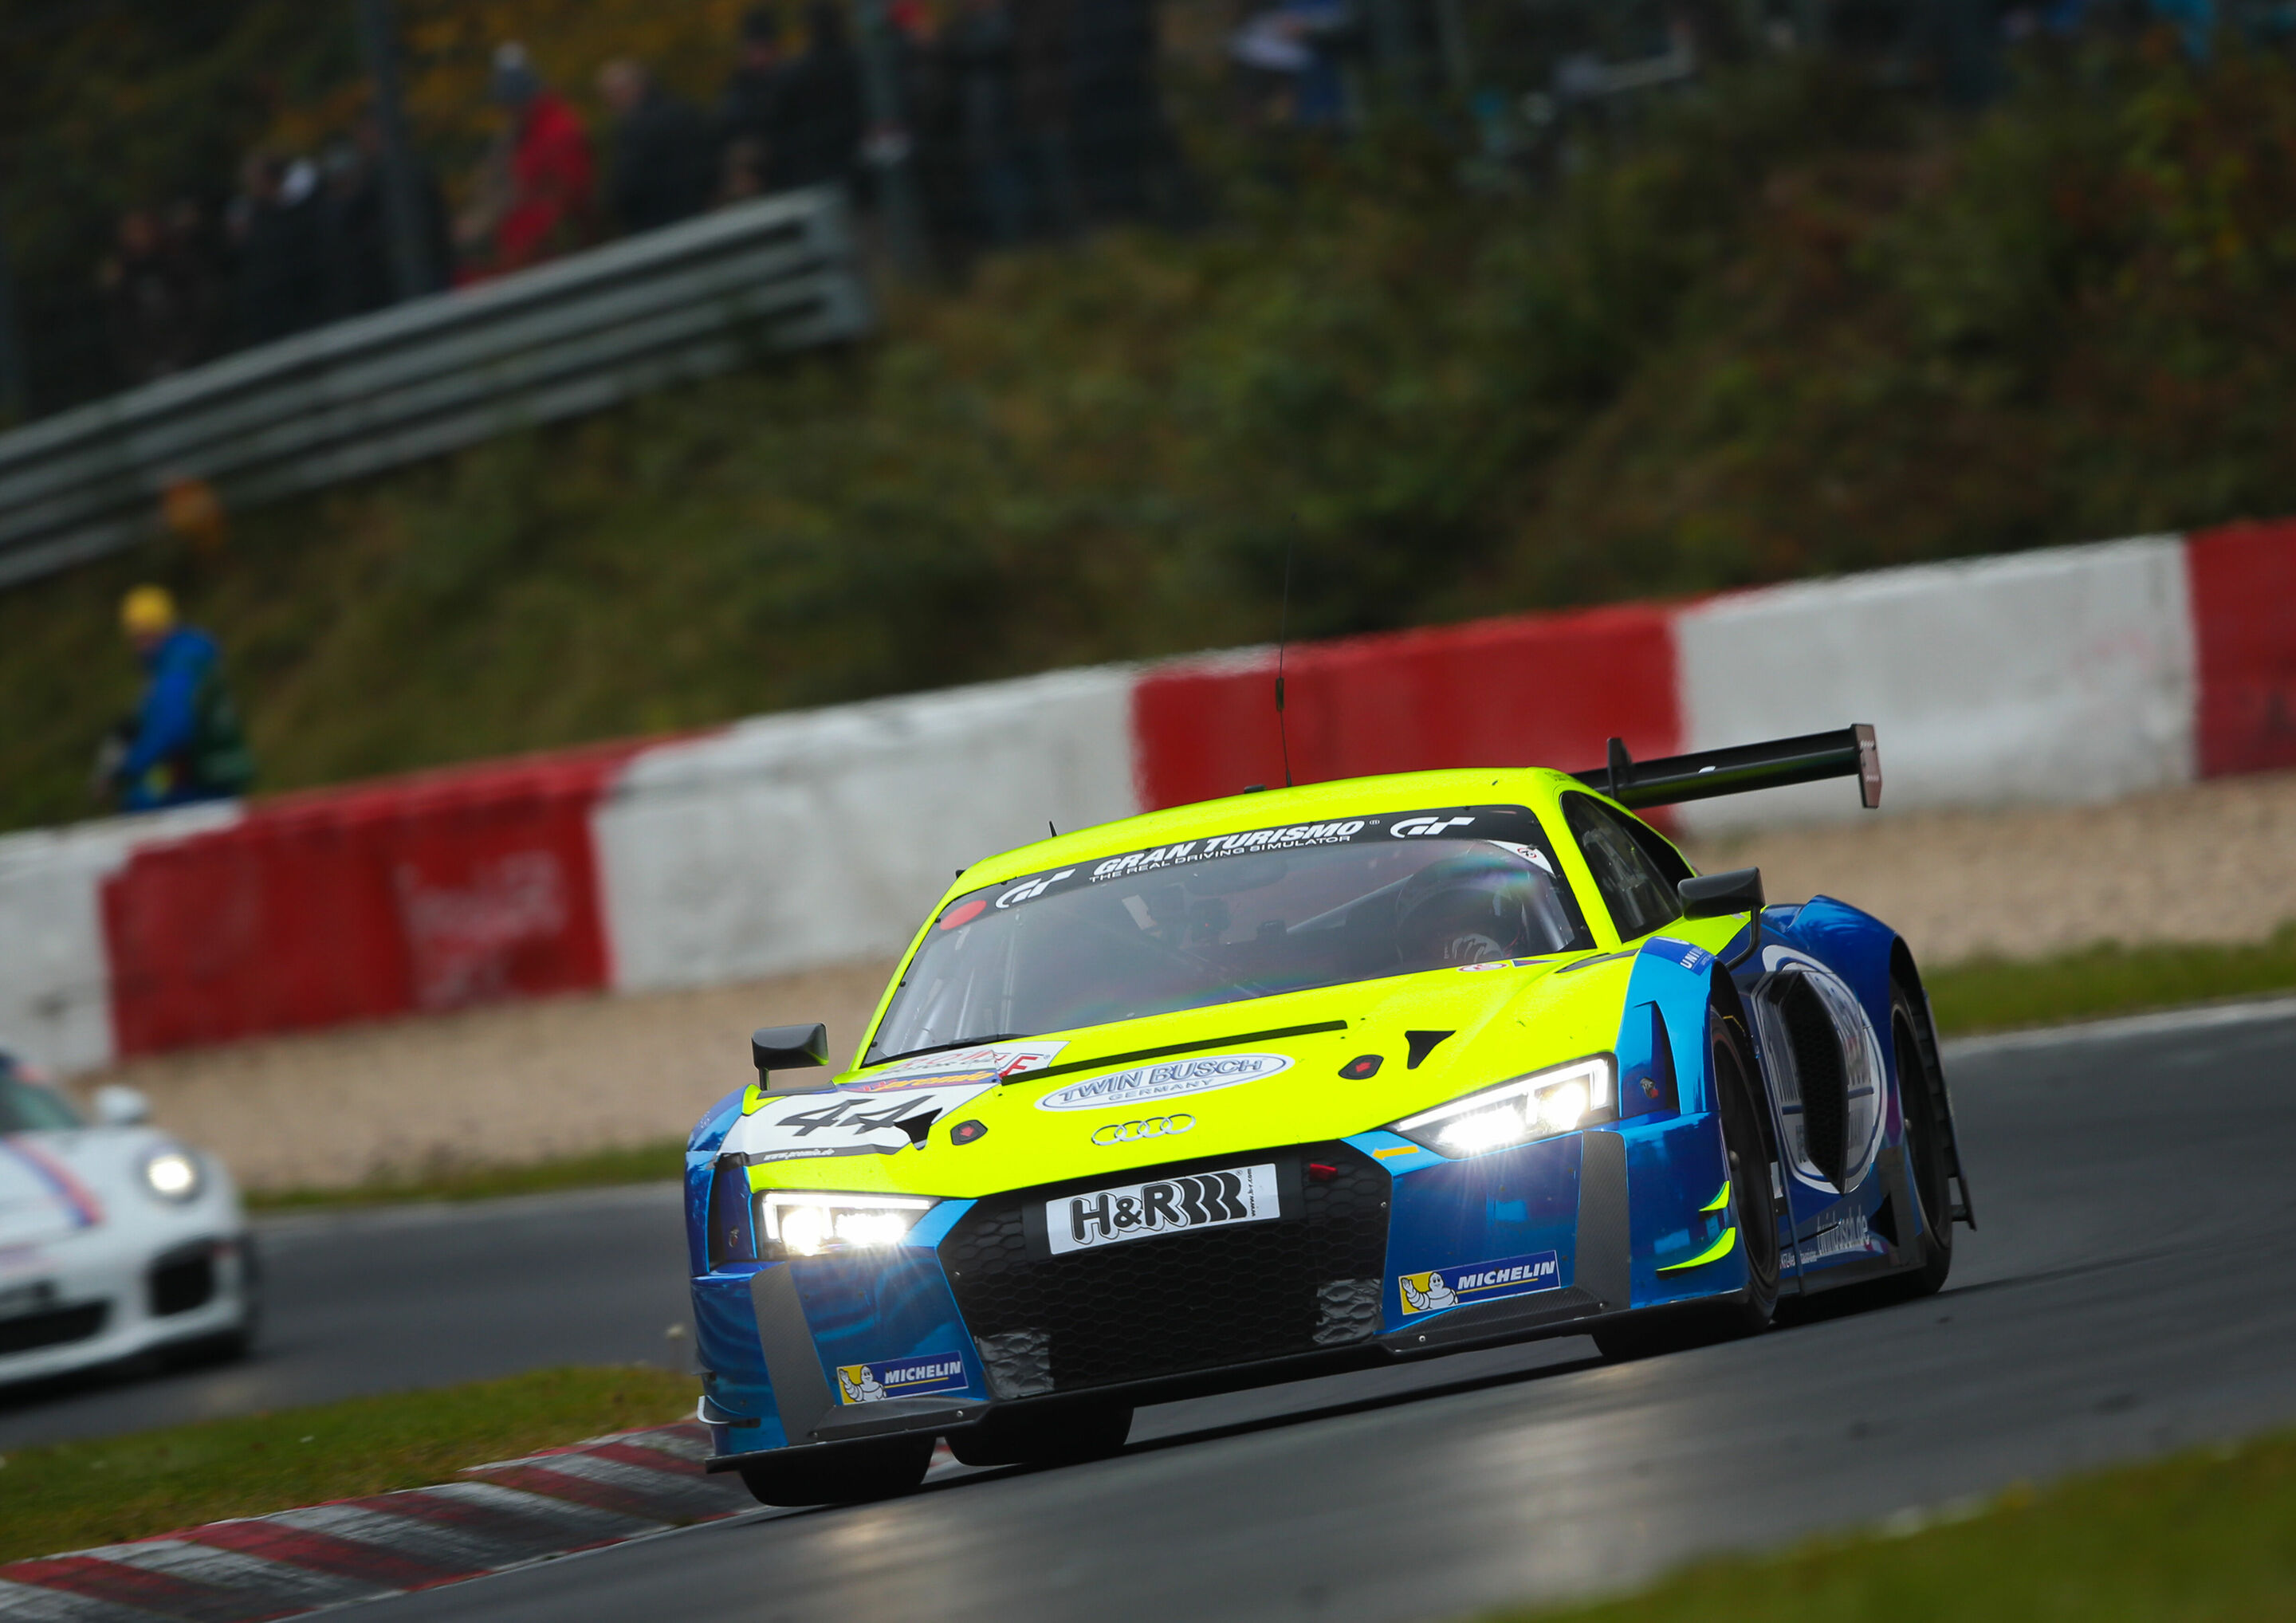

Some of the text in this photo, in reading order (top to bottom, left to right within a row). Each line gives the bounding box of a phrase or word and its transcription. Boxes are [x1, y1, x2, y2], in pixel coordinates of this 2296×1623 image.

[1089, 835, 1351, 882] THE REAL DRIVING SIMULATOR
[1093, 820, 1366, 876] GRAN TURISMO
[1059, 1059, 1263, 1102] TWIN BUSCH
[1108, 1078, 1214, 1101] GERMANY
[775, 1094, 938, 1138] 44
[1071, 1182, 1183, 1244] H&R
[1457, 1260, 1556, 1290] MICHELIN
[884, 1361, 961, 1385] MICHELIN
